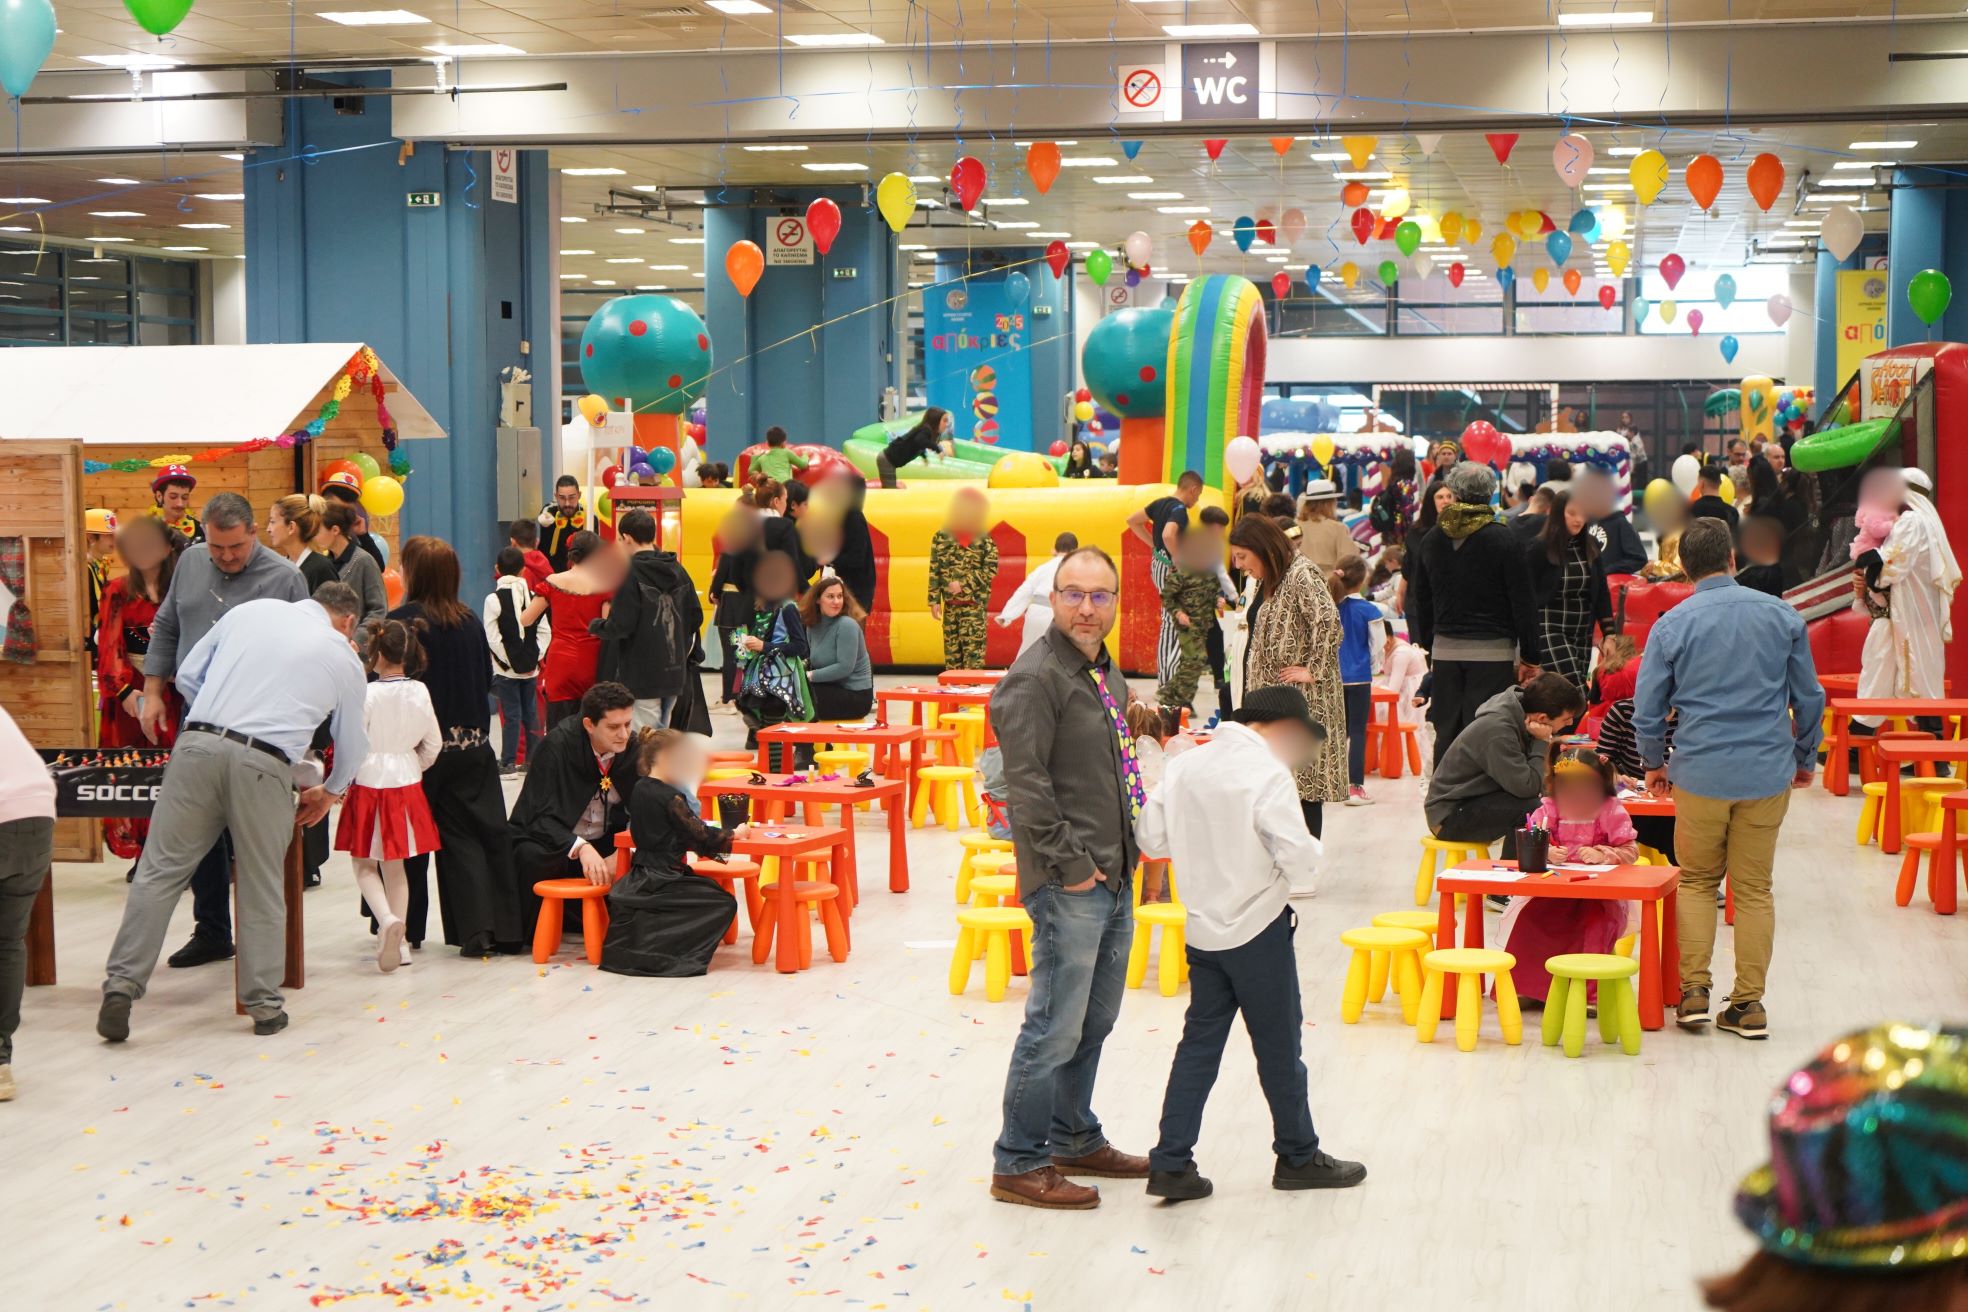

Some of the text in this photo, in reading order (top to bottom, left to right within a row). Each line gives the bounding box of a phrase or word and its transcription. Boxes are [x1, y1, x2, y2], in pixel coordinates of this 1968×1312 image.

[1192, 76, 1248, 105] WC
[1845, 318, 1884, 344] από
[77, 785, 162, 801] SOCCE
